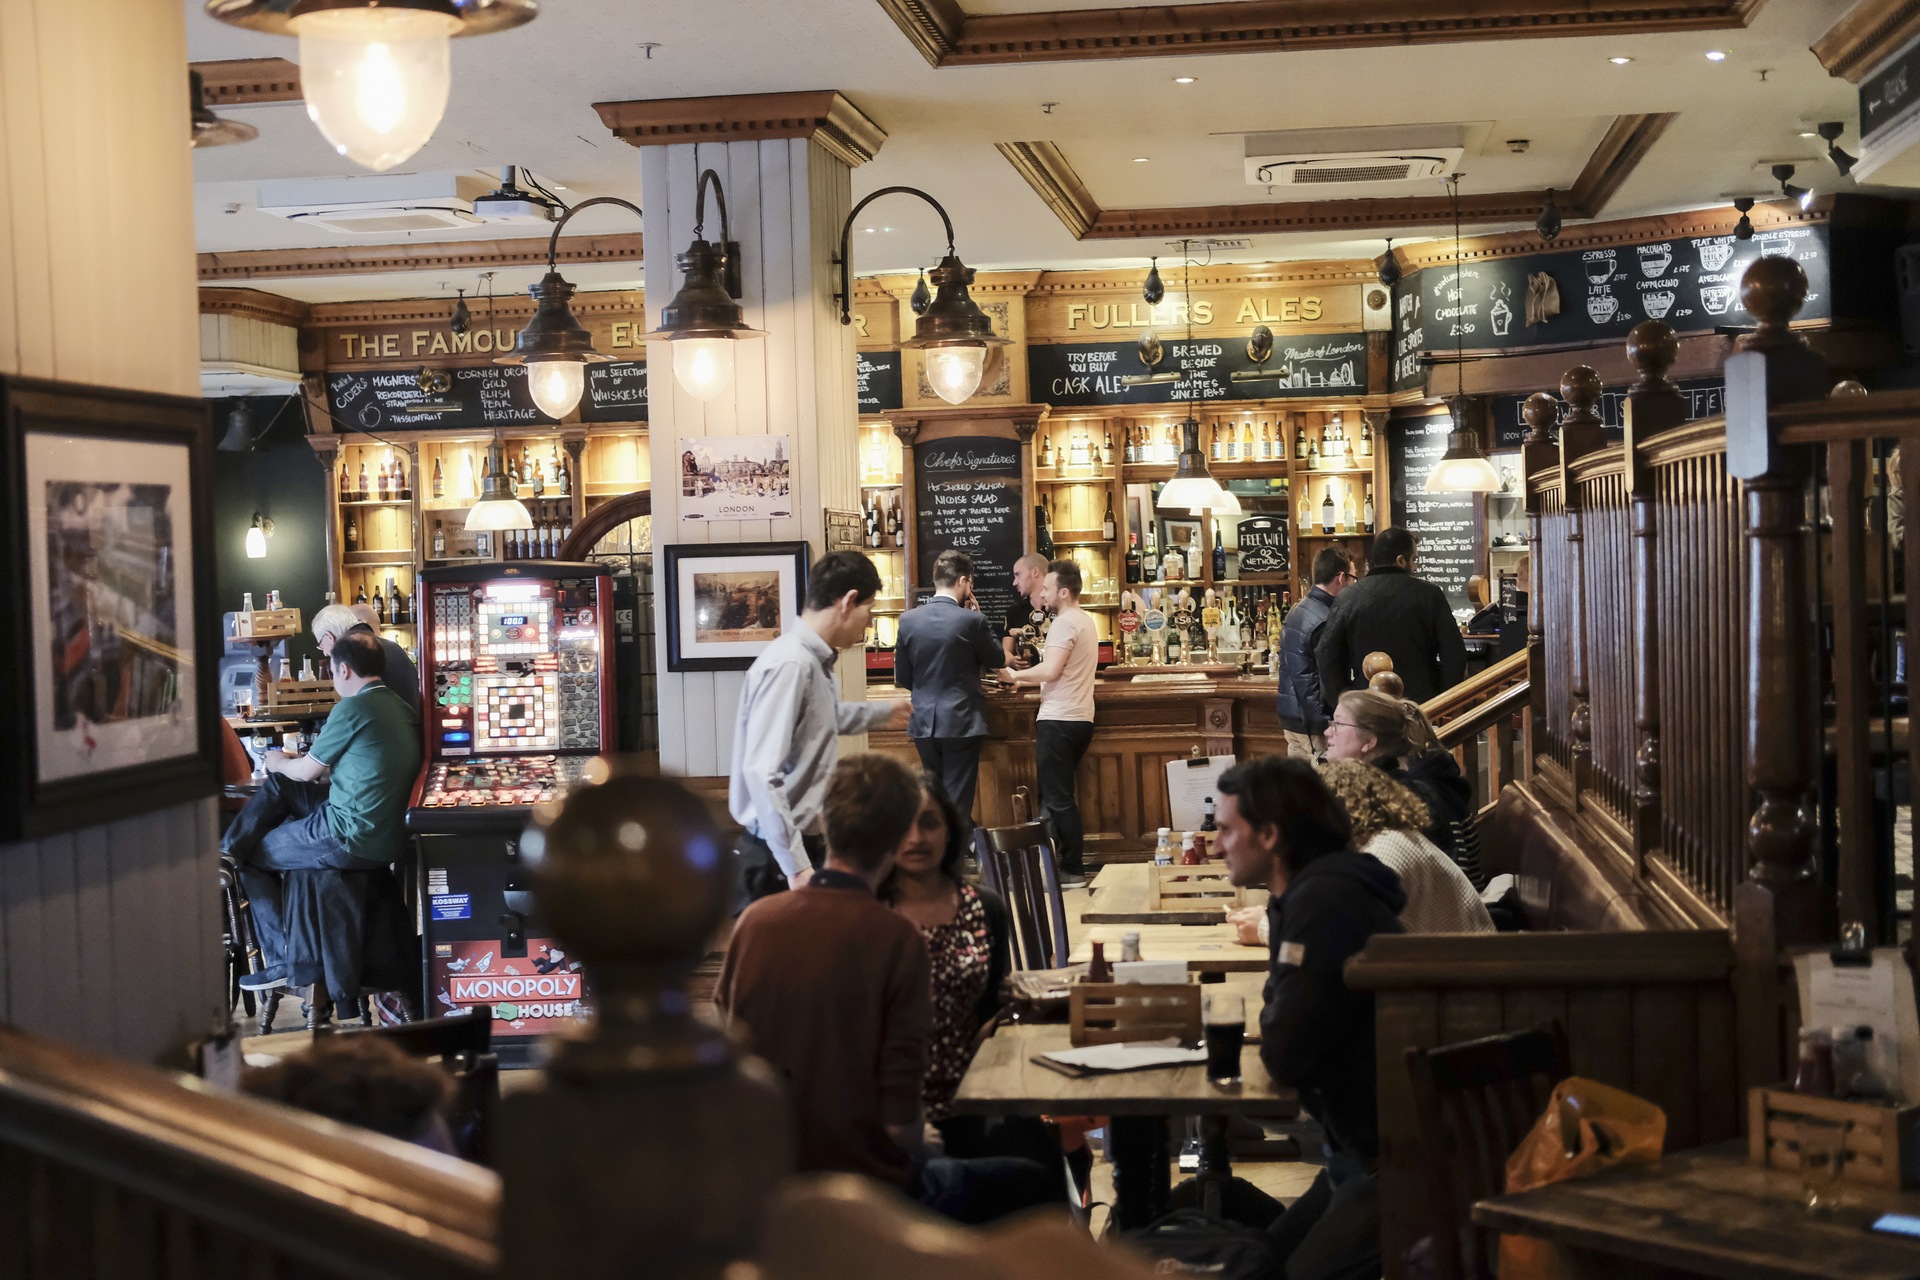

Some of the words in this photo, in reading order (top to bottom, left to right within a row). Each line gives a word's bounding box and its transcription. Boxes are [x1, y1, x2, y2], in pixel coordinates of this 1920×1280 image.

[1751, 231, 1778, 242] DOUBLE
[1582, 249, 1617, 261] ESPRESSO
[1446, 288, 1463, 302] HOT
[1067, 300, 1214, 331] FULLERS
[1235, 296, 1323, 324] ALES
[340, 333, 401, 359] THE
[1173, 344, 1222, 357] BREWED
[1284, 347, 1315, 361] Made
[1325, 341, 1364, 356] London
[1067, 353, 1086, 362] TRY
[1087, 351, 1118, 362] BEFORE
[1069, 363, 1086, 373] YOU
[1090, 362, 1109, 372] BUY
[1181, 358, 1217, 369] BESIDE
[457, 369, 499, 379] CORNISH
[1052, 376, 1091, 396] CASK
[336, 377, 368, 409] CIDERS
[924, 450, 962, 470] Chef's
[964, 450, 1016, 470] Signatures
[971, 493, 998, 504] SALAD
[718, 505, 756, 513] LONDON
[1240, 533, 1262, 546] FREE
[1263, 532, 1284, 546] WIFI
[1246, 557, 1281, 566] NETWORK
[432, 897, 469, 906] KOSSWAY
[455, 977, 577, 999] MONOPOLY
[517, 1002, 573, 1019] HOUSE
